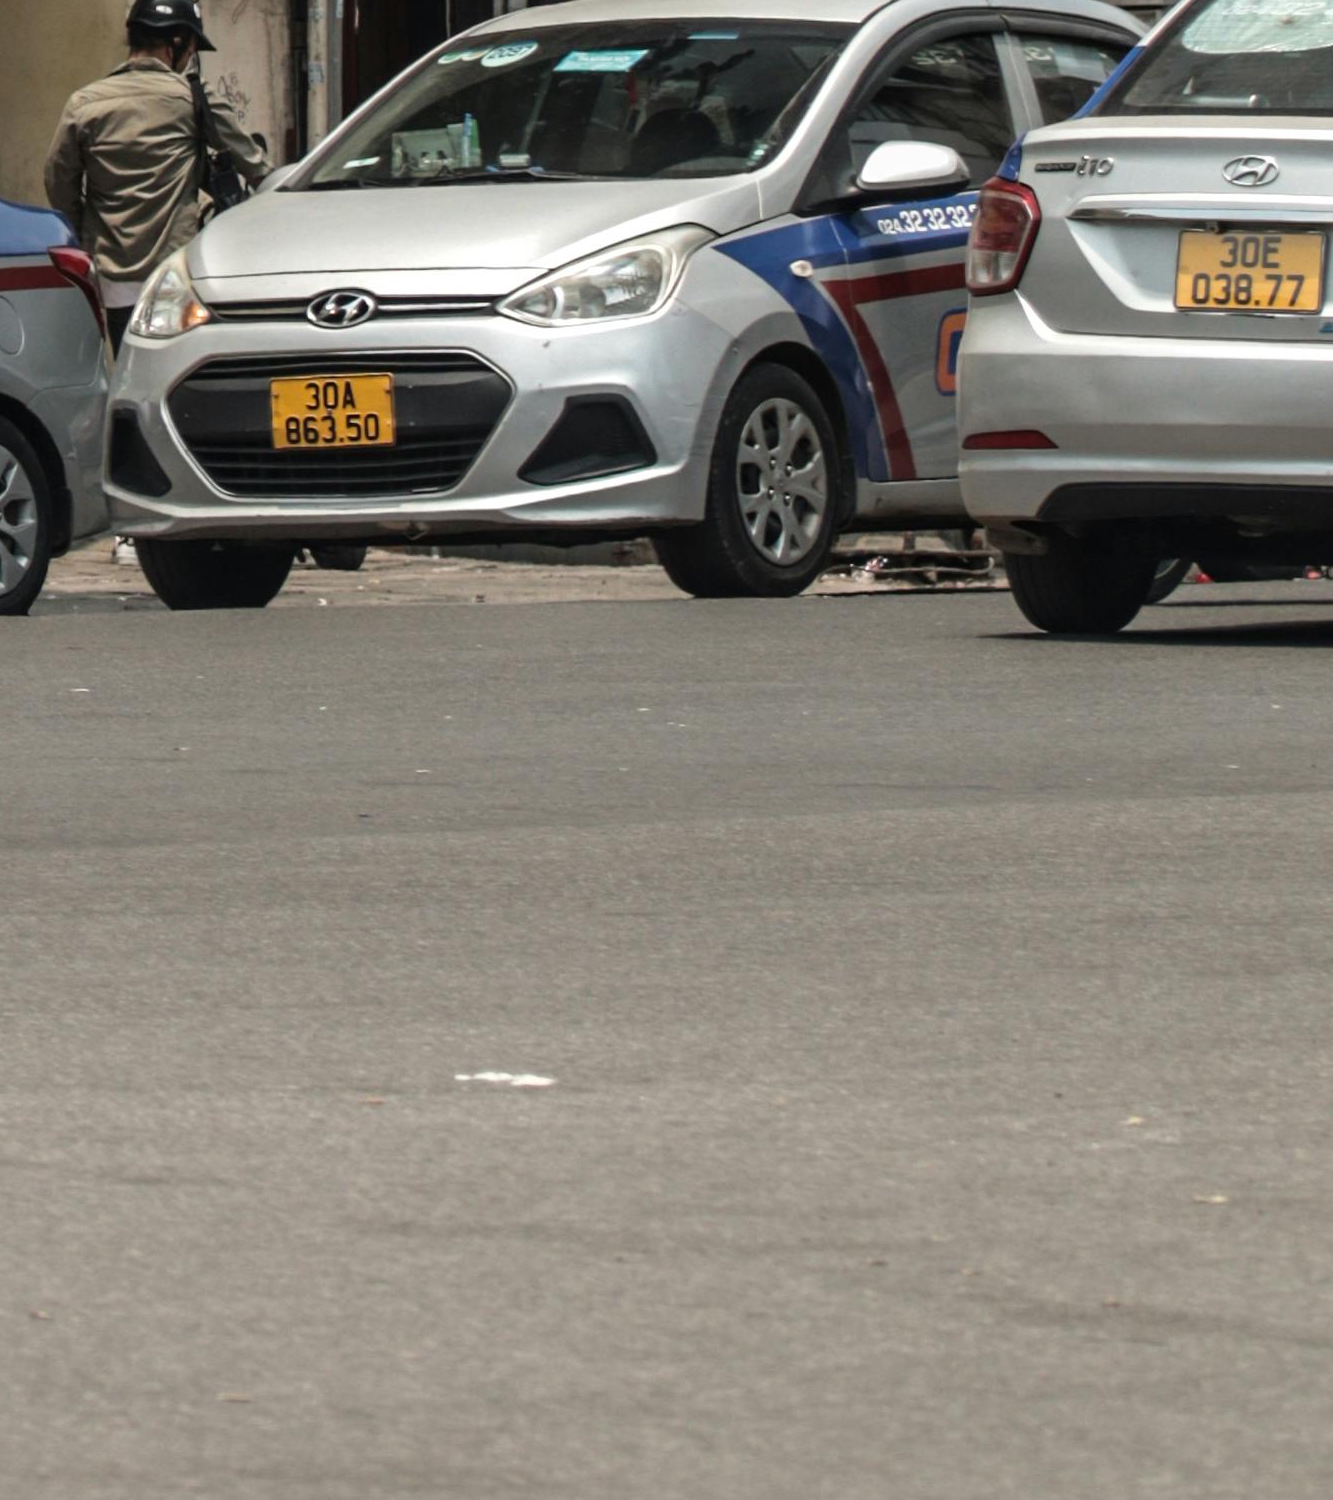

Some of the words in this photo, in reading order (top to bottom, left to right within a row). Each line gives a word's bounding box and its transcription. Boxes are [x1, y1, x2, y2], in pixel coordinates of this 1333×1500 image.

[922, 206, 947, 231] 32
[946, 203, 972, 228] 32
[1220, 236, 1282, 268] 30E
[1192, 272, 1305, 307] 038.77
[305, 380, 356, 410] 30A
[285, 413, 379, 444] 863.50
